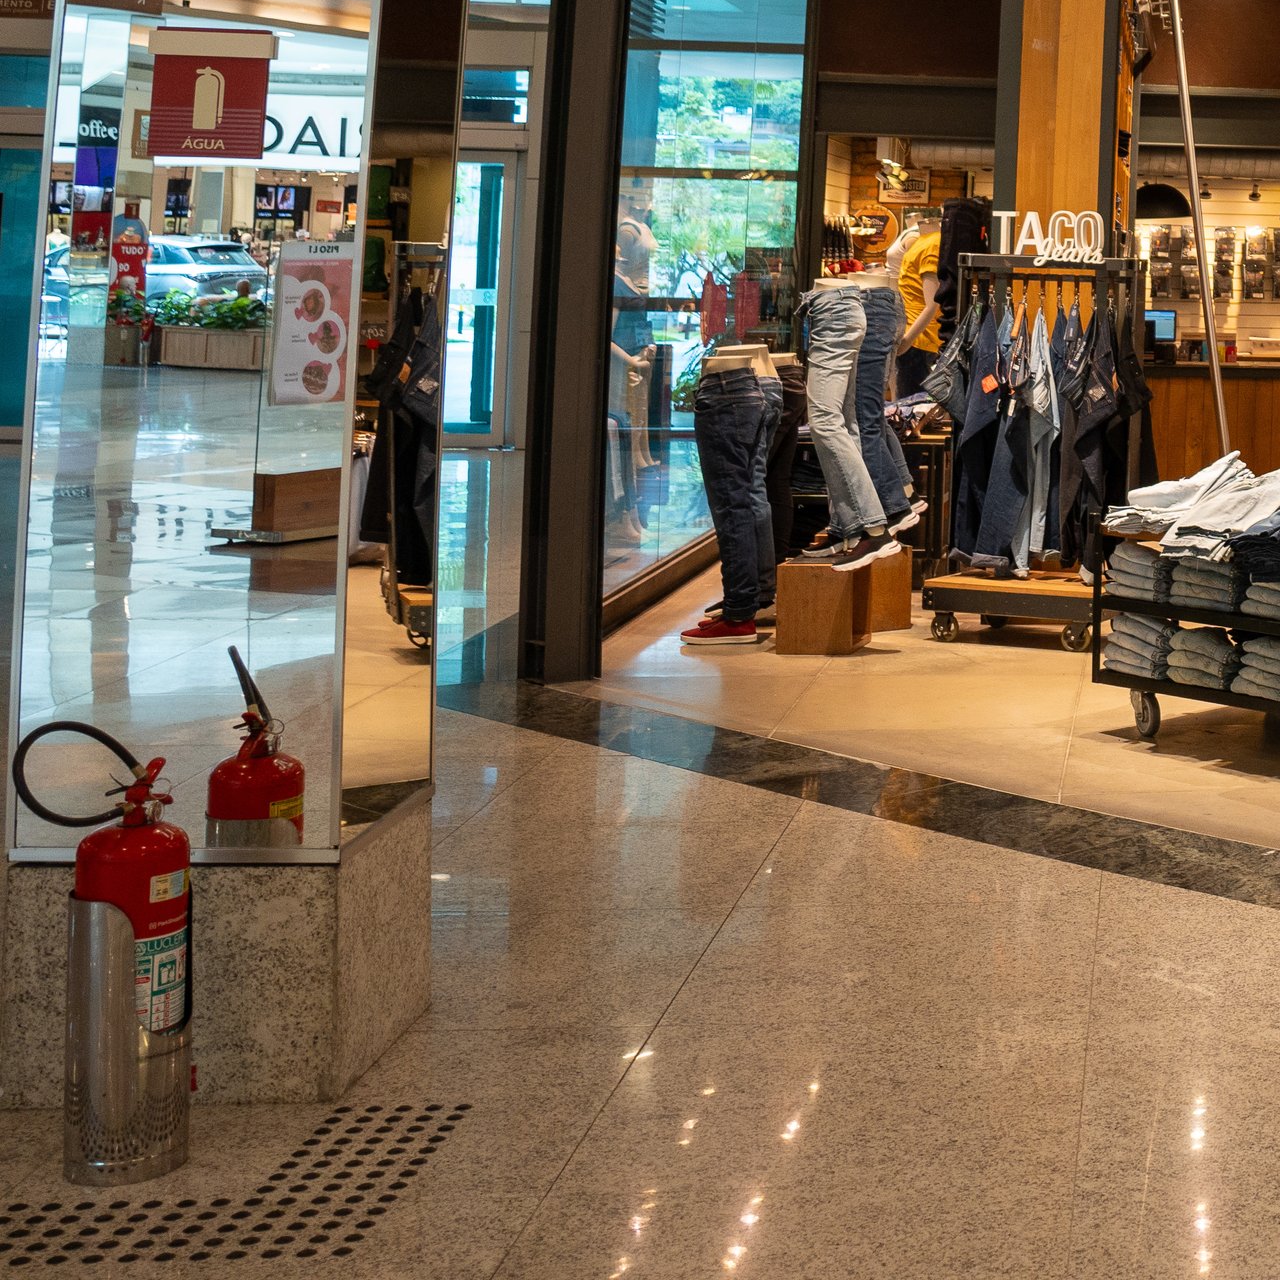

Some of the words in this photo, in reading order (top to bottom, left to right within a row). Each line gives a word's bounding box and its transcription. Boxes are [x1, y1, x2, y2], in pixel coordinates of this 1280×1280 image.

[181, 135, 225, 151] ÁGUA
[992, 210, 1105, 255] TACO
[121, 245, 144, 255] TUDO
